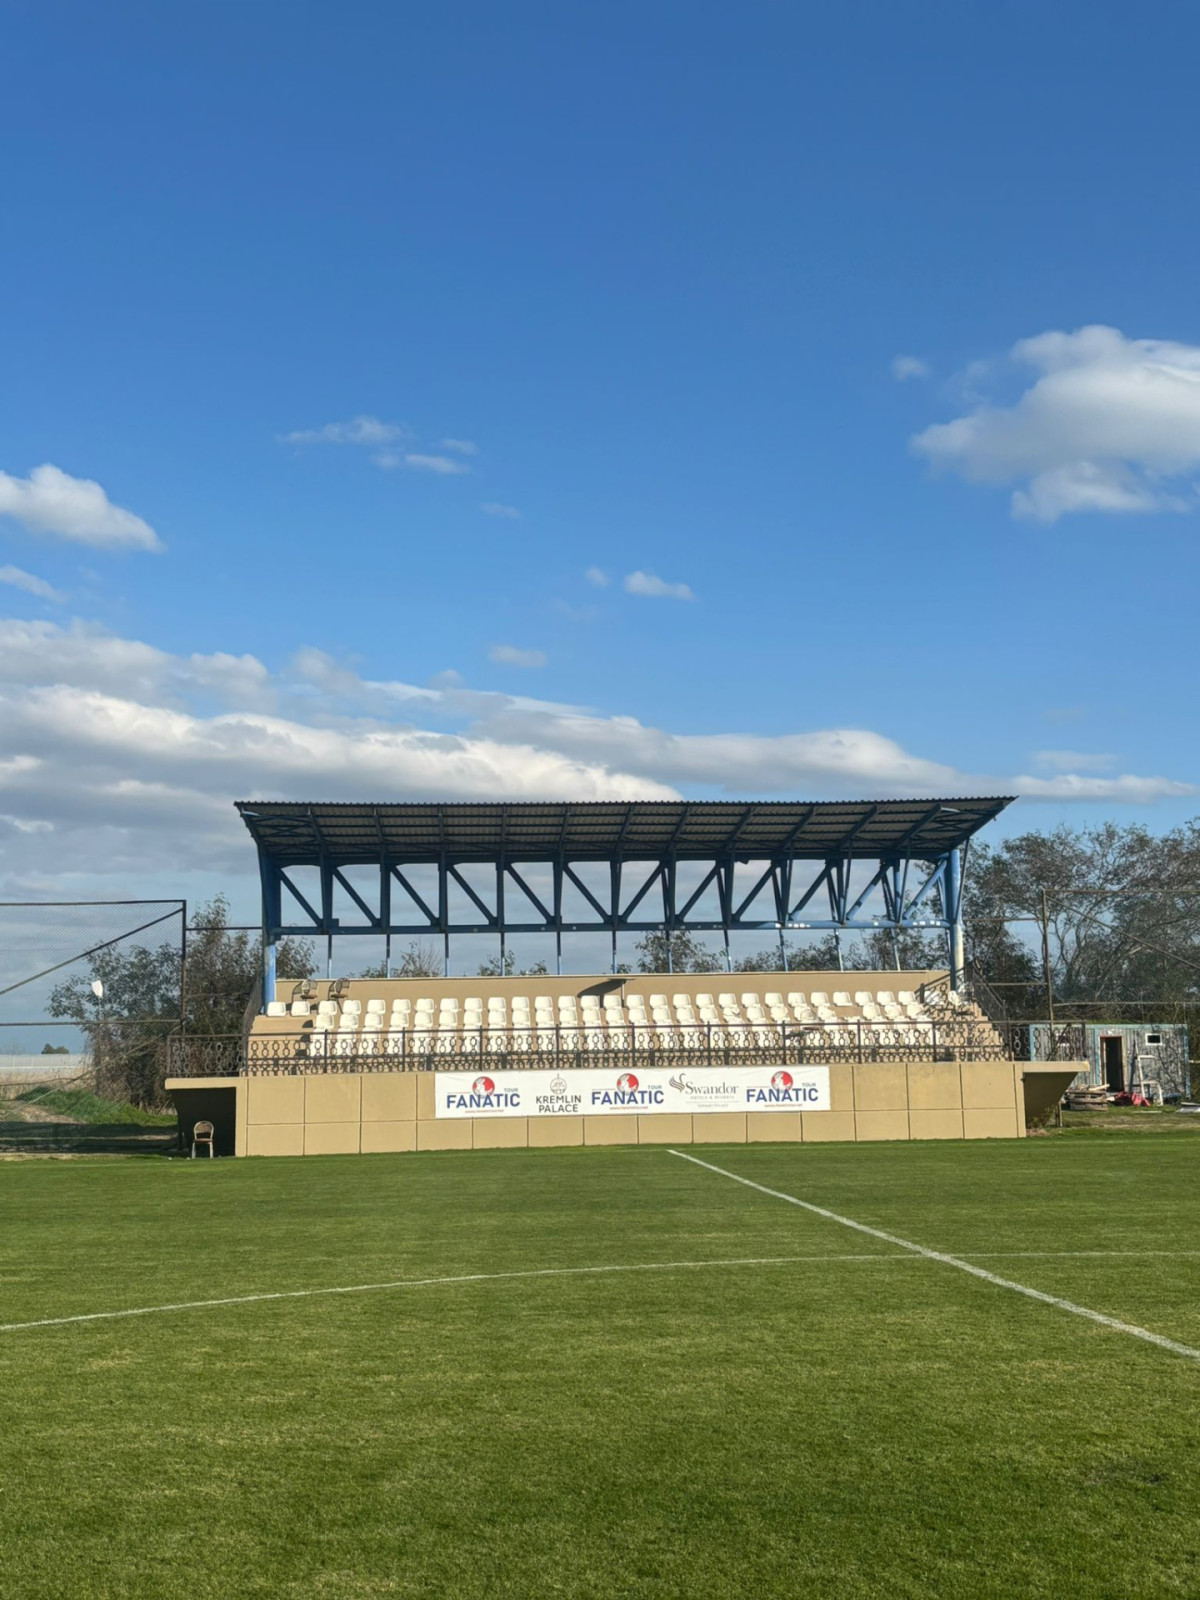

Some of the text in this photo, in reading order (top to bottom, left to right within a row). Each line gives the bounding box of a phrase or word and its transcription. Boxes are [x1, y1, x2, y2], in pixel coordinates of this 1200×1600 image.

[685, 1081, 739, 1095] Swandor
[746, 1088, 818, 1102] FANATIC
[446, 1093, 520, 1108] FANATIC
[535, 1095, 582, 1104] KREMLIN
[591, 1090, 664, 1105] FANATIC
[538, 1104, 579, 1113] PALACE
